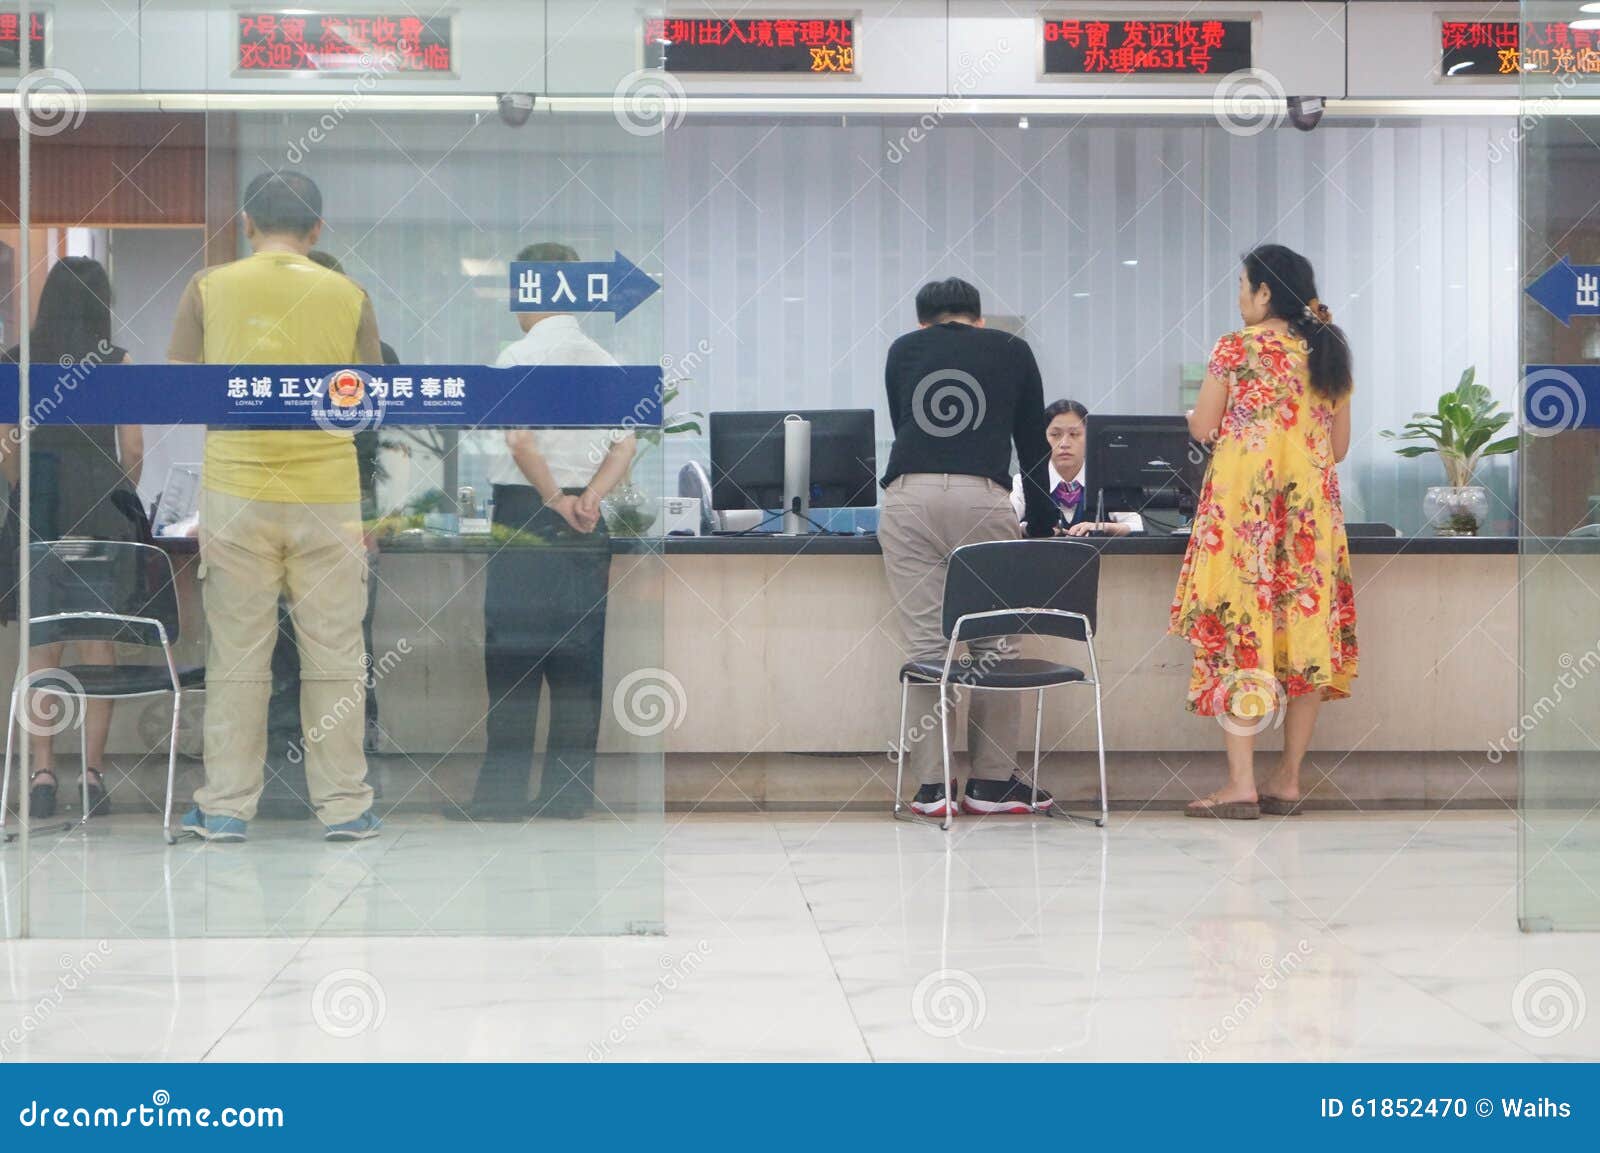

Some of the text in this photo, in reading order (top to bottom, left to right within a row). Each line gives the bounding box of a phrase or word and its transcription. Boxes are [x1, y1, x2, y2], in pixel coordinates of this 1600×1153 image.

[646, 19, 852, 47] 深圳出入境管理处
[1044, 20, 1226, 48] 8号窗 发证收费
[1442, 21, 1600, 49] 深圳出入境管
[810, 46, 853, 71] 欢迎
[1083, 46, 1212, 74] 办理A631号
[1497, 47, 1600, 75] 欢迎光临
[518, 269, 609, 305] 出入口
[1576, 273, 1600, 307] 出
[227, 377, 466, 398] 忠诚 正义 为民 奉献
